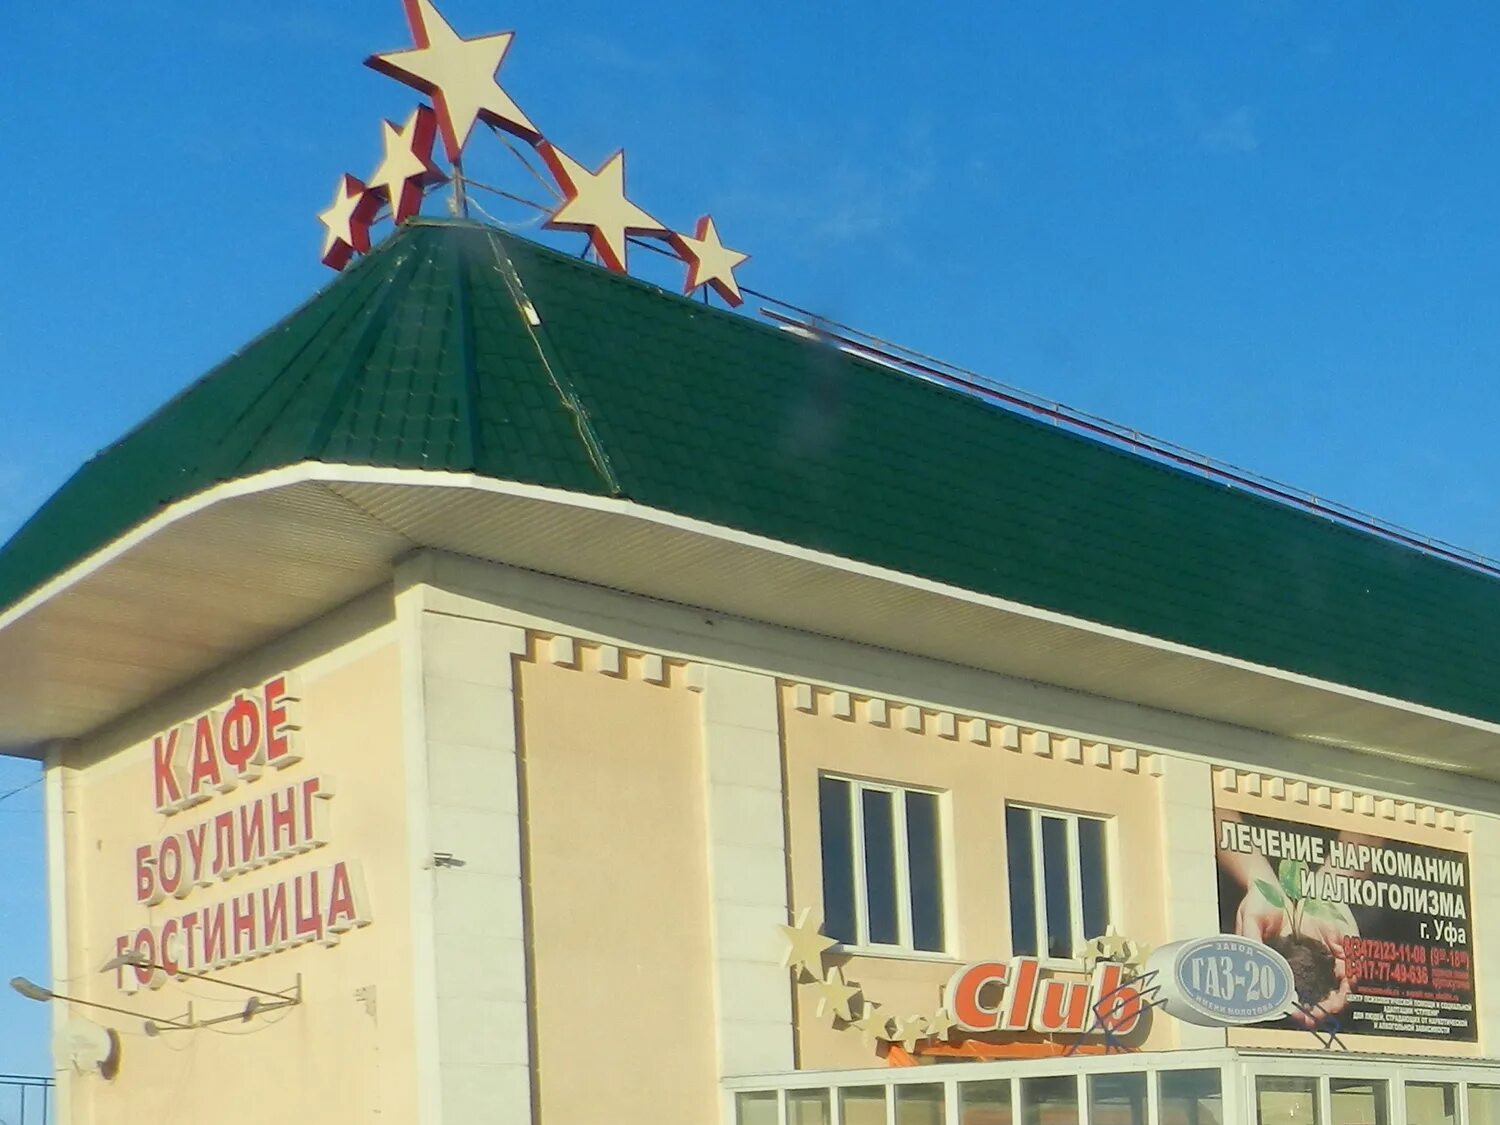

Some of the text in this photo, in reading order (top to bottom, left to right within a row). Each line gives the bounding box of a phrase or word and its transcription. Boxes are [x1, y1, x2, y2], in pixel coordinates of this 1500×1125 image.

[151, 673, 297, 813] КАФЕ
[135, 776, 327, 905] БОУЛИНГ
[1220, 821, 1466, 887] ЛЕЧЕНИЕ НАРКОМАНИИ
[115, 861, 360, 992] ГОСТИНИЦА
[1301, 869, 1467, 919] И АЛКОГОЛИЗМА
[1216, 942, 1254, 956] ЗАВОД
[1420, 921, 1466, 948] г. Уфа
[947, 955, 1144, 1035] Club
[1191, 956, 1276, 1001] ГАЗ-20
